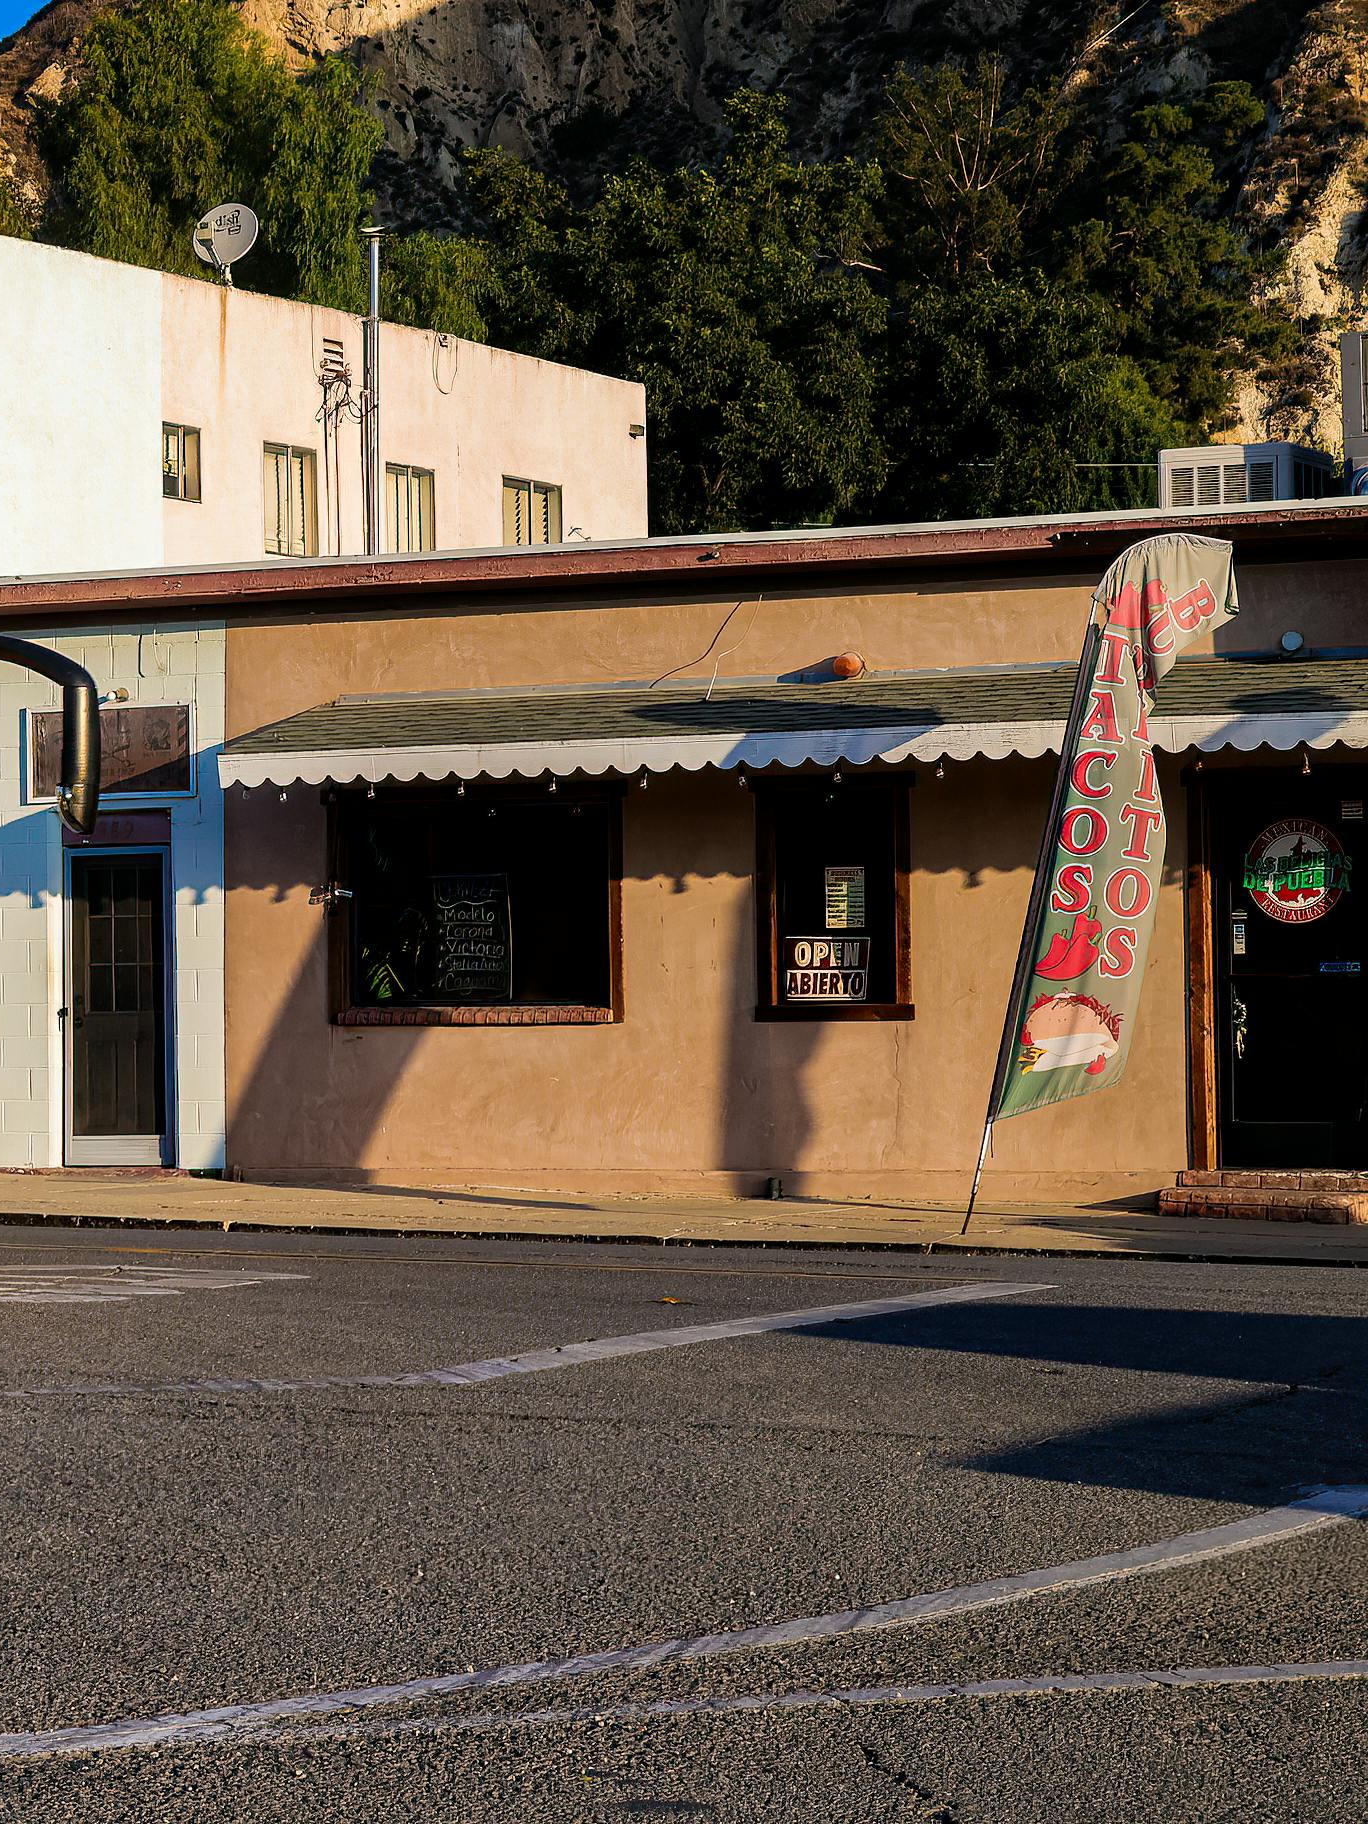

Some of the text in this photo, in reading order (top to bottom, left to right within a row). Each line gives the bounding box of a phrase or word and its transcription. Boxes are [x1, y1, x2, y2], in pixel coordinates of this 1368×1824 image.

[1050, 629, 1131, 915] TACOS
[1261, 821, 1329, 842] MEXICAN
[1243, 870, 1351, 892] DE PUEBLA
[444, 905, 494, 921] Modelo
[1261, 896, 1334, 921] RESTAURANT
[446, 923, 493, 938] Corona
[446, 940, 504, 955] Victoria
[794, 941, 860, 967] OPEN
[787, 971, 865, 996] ABIERTO
